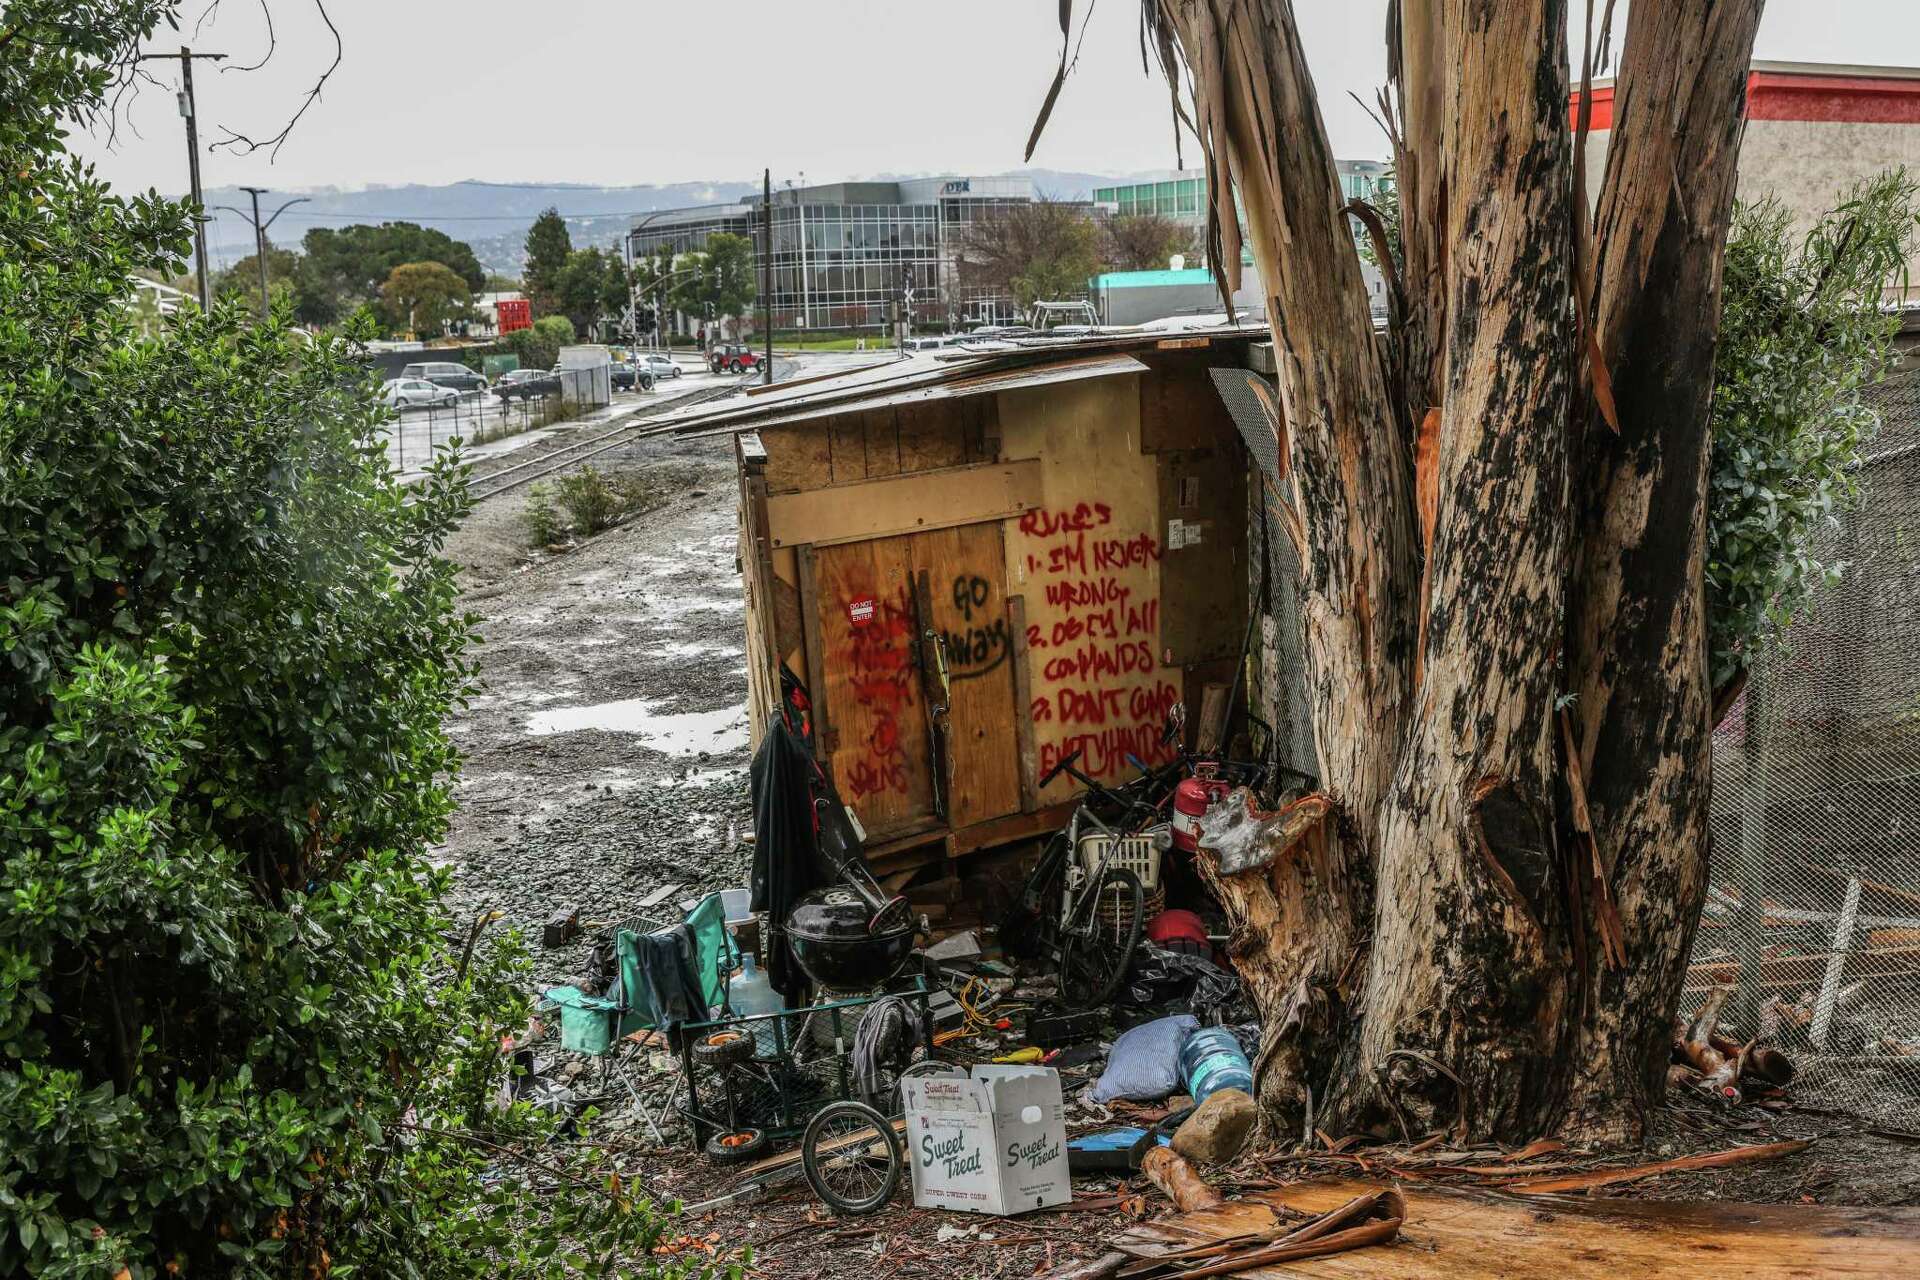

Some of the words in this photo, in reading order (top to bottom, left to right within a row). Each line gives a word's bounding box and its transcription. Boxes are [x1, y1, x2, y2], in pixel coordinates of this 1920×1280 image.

[1019, 503, 1112, 537] RULES
[850, 602, 860, 610] DO
[860, 600, 873, 608] NOT
[852, 612, 872, 622] ENTER
[922, 1130, 965, 1168] Sweet
[943, 1147, 982, 1180] Treat
[1007, 1132, 1048, 1167] Sweet
[1027, 1142, 1060, 1170] Treat
